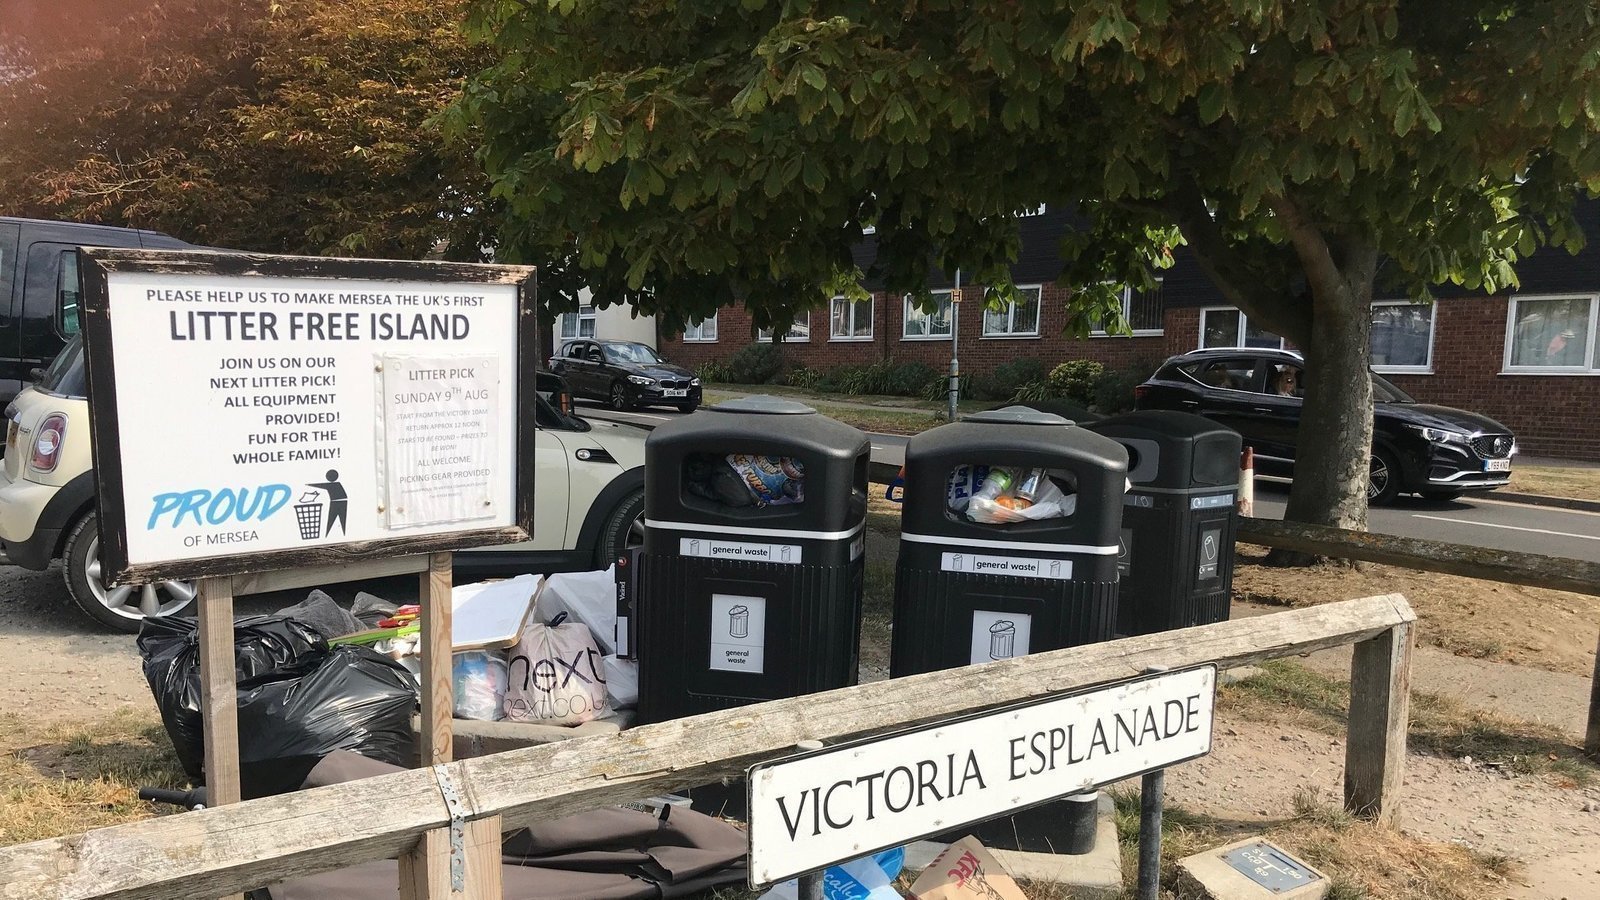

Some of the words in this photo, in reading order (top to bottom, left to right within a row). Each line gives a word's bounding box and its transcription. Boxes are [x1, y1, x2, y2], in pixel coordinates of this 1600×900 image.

[146, 289, 203, 302] PLEASE
[207, 291, 244, 303] HELP
[248, 291, 267, 304] US
[271, 292, 290, 304] TO
[295, 293, 335, 305] MAKE
[339, 294, 392, 305] MERSEA
[396, 295, 419, 306] THE
[423, 295, 450, 306] UK'S
[453, 296, 485, 307] FIRST
[169, 310, 279, 341] LITTER
[290, 312, 360, 341] FREE
[370, 312, 470, 341] ISLAND
[220, 358, 253, 370] JOIN
[257, 357, 276, 369] US
[280, 357, 301, 369] ON
[306, 357, 336, 368] OUR
[210, 377, 248, 389] NEXT
[252, 376, 297, 388] LITTER
[301, 375, 336, 387] PICK!
[409, 369, 447, 381] LITTER
[450, 368, 475, 379] PICK
[224, 396, 249, 408] ALL
[253, 393, 337, 408] EQUIPMENT
[394, 391, 442, 405] SUNDAY
[464, 389, 489, 401] AUG
[265, 411, 340, 426] PROVIDED!
[396, 413, 414, 421] START
[415, 411, 434, 419] FROM
[446, 409, 471, 418] VICTORY
[472, 408, 488, 416] 10AM
[406, 424, 429, 432] RETURN
[430, 423, 453, 431] APPROX
[462, 421, 480, 429] NOON
[248, 433, 277, 445] FUN
[281, 431, 309, 443] FOR
[312, 430, 338, 441] THE
[434, 434, 456, 442] FOUND
[233, 451, 285, 464] WHOLE
[288, 447, 341, 461] FAMILY!
[417, 459, 430, 467] ALL
[432, 455, 471, 466] WELCOME
[399, 474, 430, 484] PICKING
[431, 472, 452, 481] GEAR
[453, 468, 491, 479] PROVIDED
[147, 483, 292, 530] PROUD
[183, 534, 202, 547] OF
[206, 530, 259, 546] MERSEA
[712, 546, 742, 555] general
[744, 548, 768, 556] waste
[976, 560, 1009, 569] general
[1010, 563, 1037, 571] waste
[507, 646, 607, 693] next
[775, 748, 987, 842] VICTORIA
[1008, 693, 1200, 781] ESPLANADE
[947, 850, 981, 889] KFC
